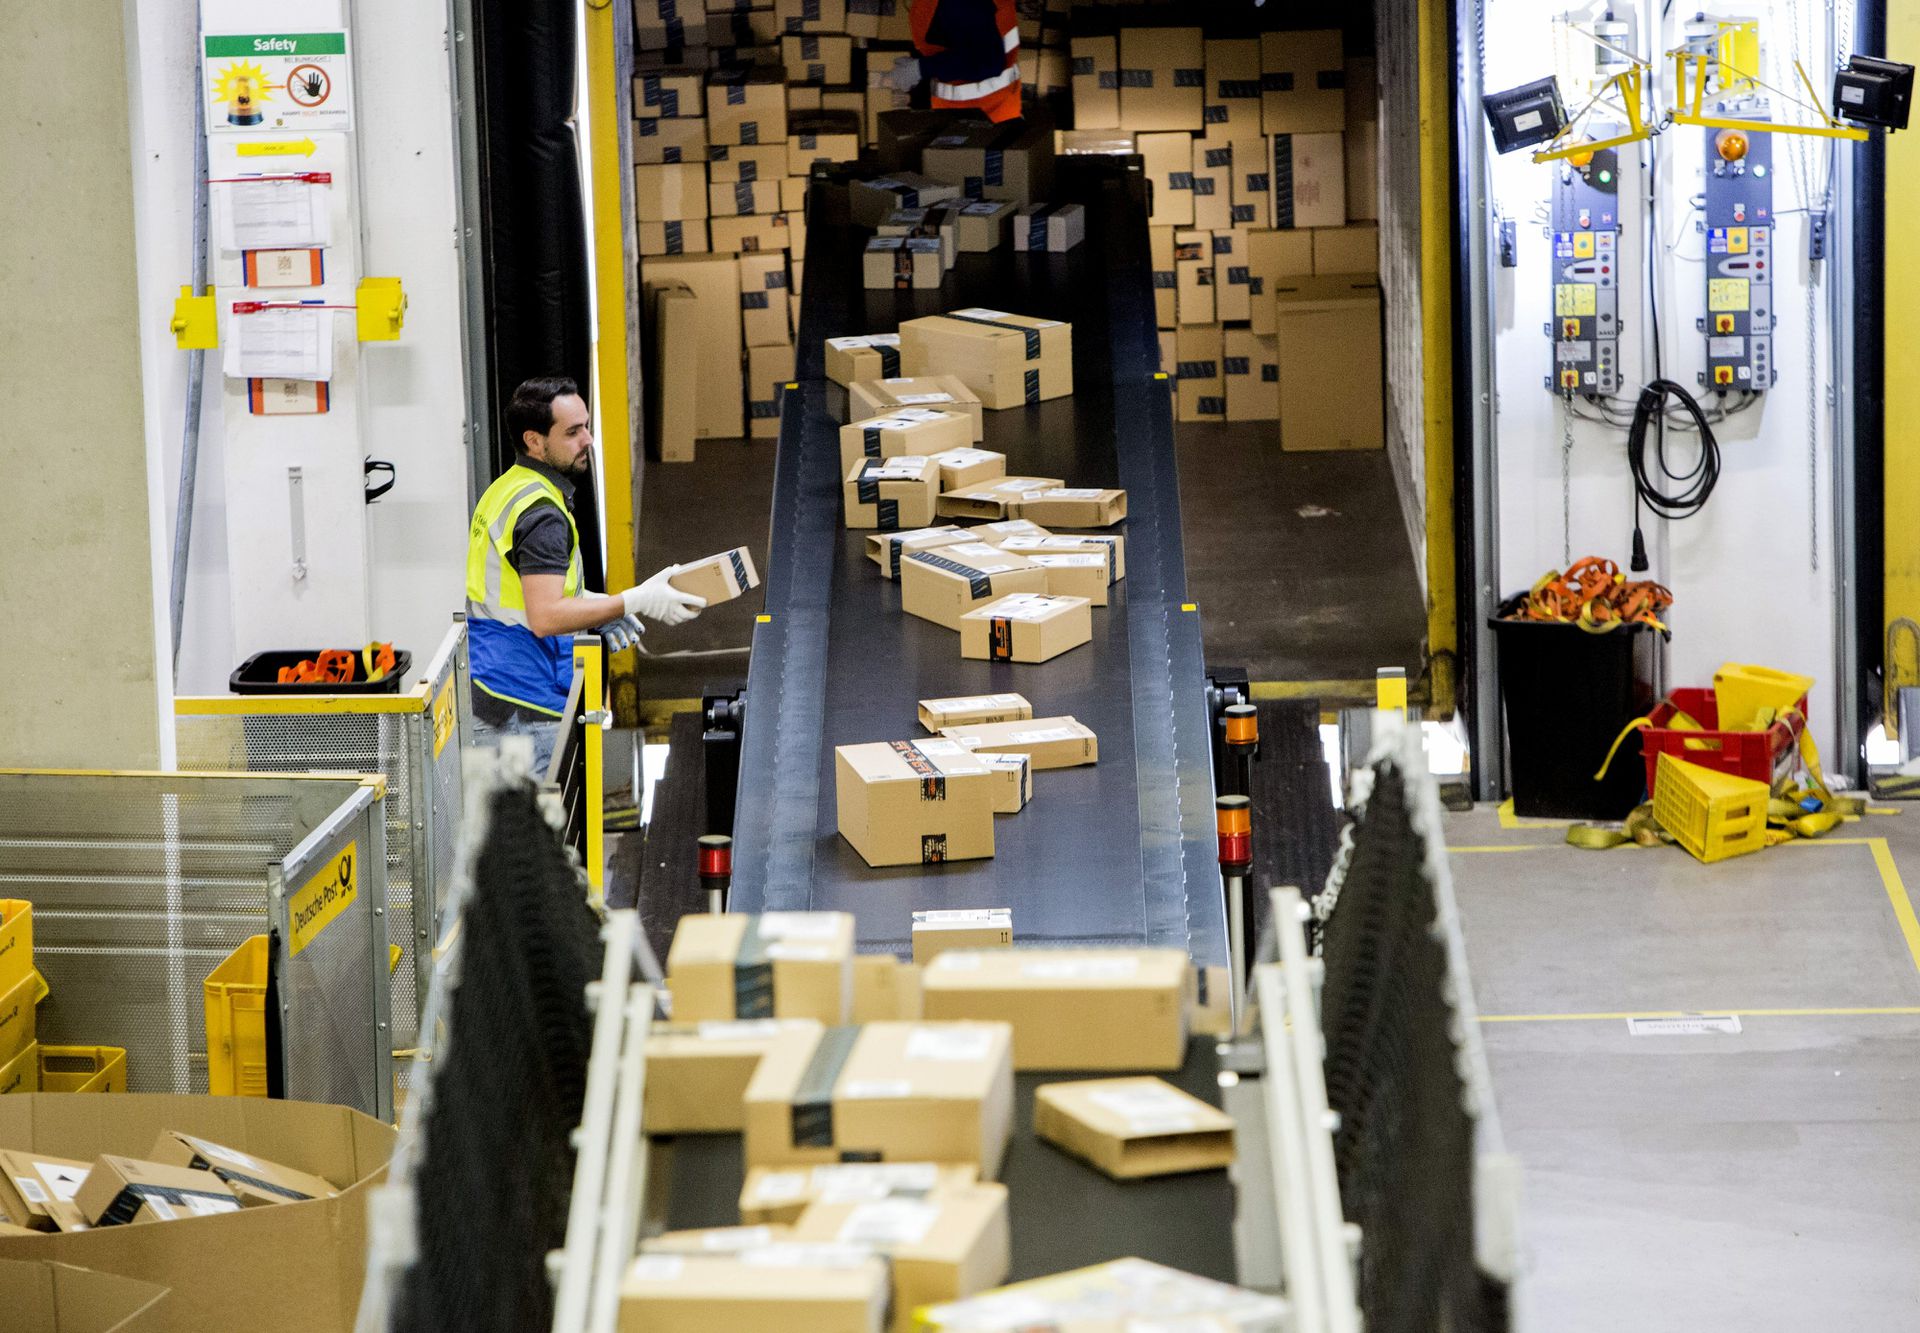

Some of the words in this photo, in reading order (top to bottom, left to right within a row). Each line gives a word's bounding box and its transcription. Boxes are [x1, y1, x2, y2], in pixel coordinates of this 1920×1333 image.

[253, 37, 297, 53] Safety
[294, 894, 323, 934] Deutsche
[323, 878, 338, 907] Post
